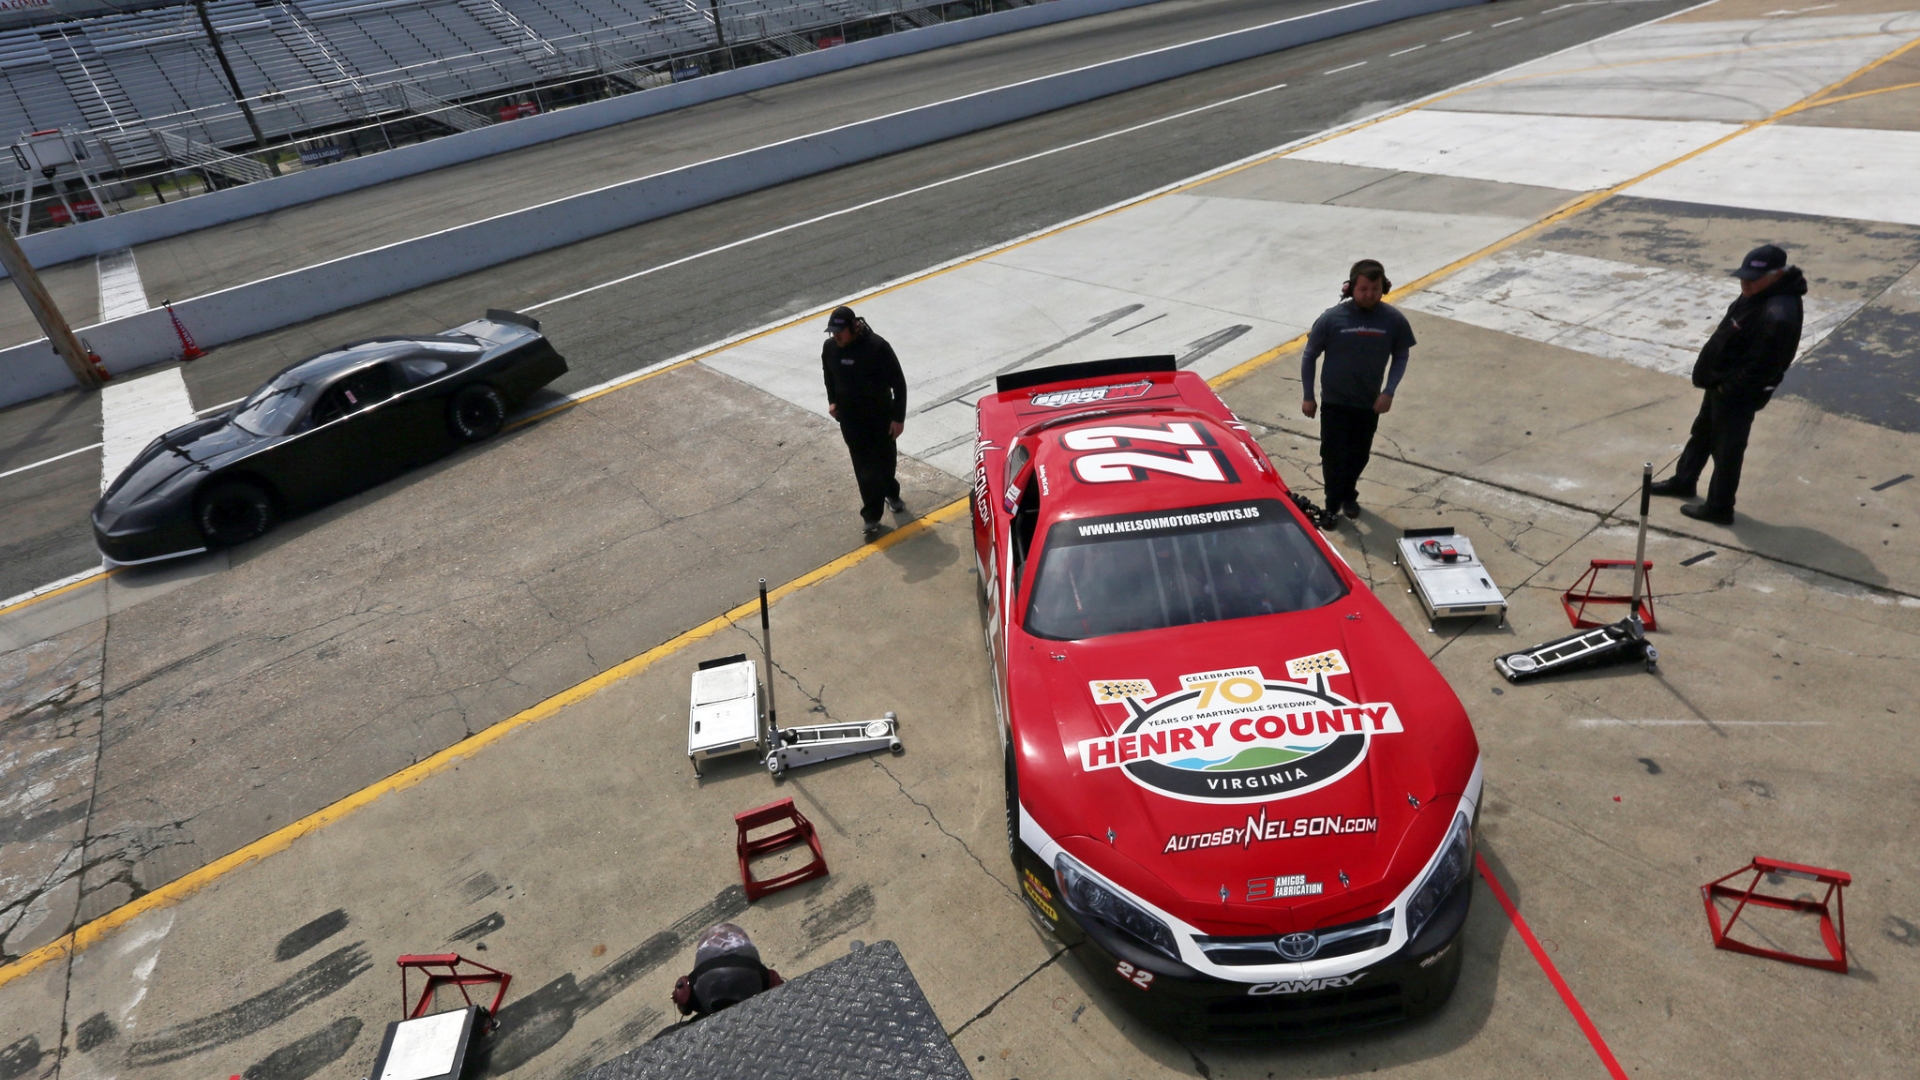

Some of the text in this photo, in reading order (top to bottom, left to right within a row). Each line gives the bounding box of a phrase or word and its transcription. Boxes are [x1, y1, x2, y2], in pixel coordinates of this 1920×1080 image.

[319, 149, 340, 158] LIGHT
[1058, 420, 1241, 485] 22
[1078, 506, 1260, 537] WWW.NELSONMOTORSPORTS.US
[1185, 669, 1255, 683] CELEBRATING
[1188, 677, 1263, 709] 70
[1148, 717, 1179, 727] YEARS
[1196, 705, 1265, 719] MARTINSVILLE
[1266, 700, 1317, 711] SPEEDWAY
[1088, 706, 1389, 767] HENRY COUNTY
[1206, 768, 1308, 790] VIRGINIA
[1275, 883, 1323, 898] FABRICATION
[1276, 874, 1306, 887] AMIGOS
[1116, 961, 1153, 989] 22
[1247, 972, 1369, 996] CAMRY
